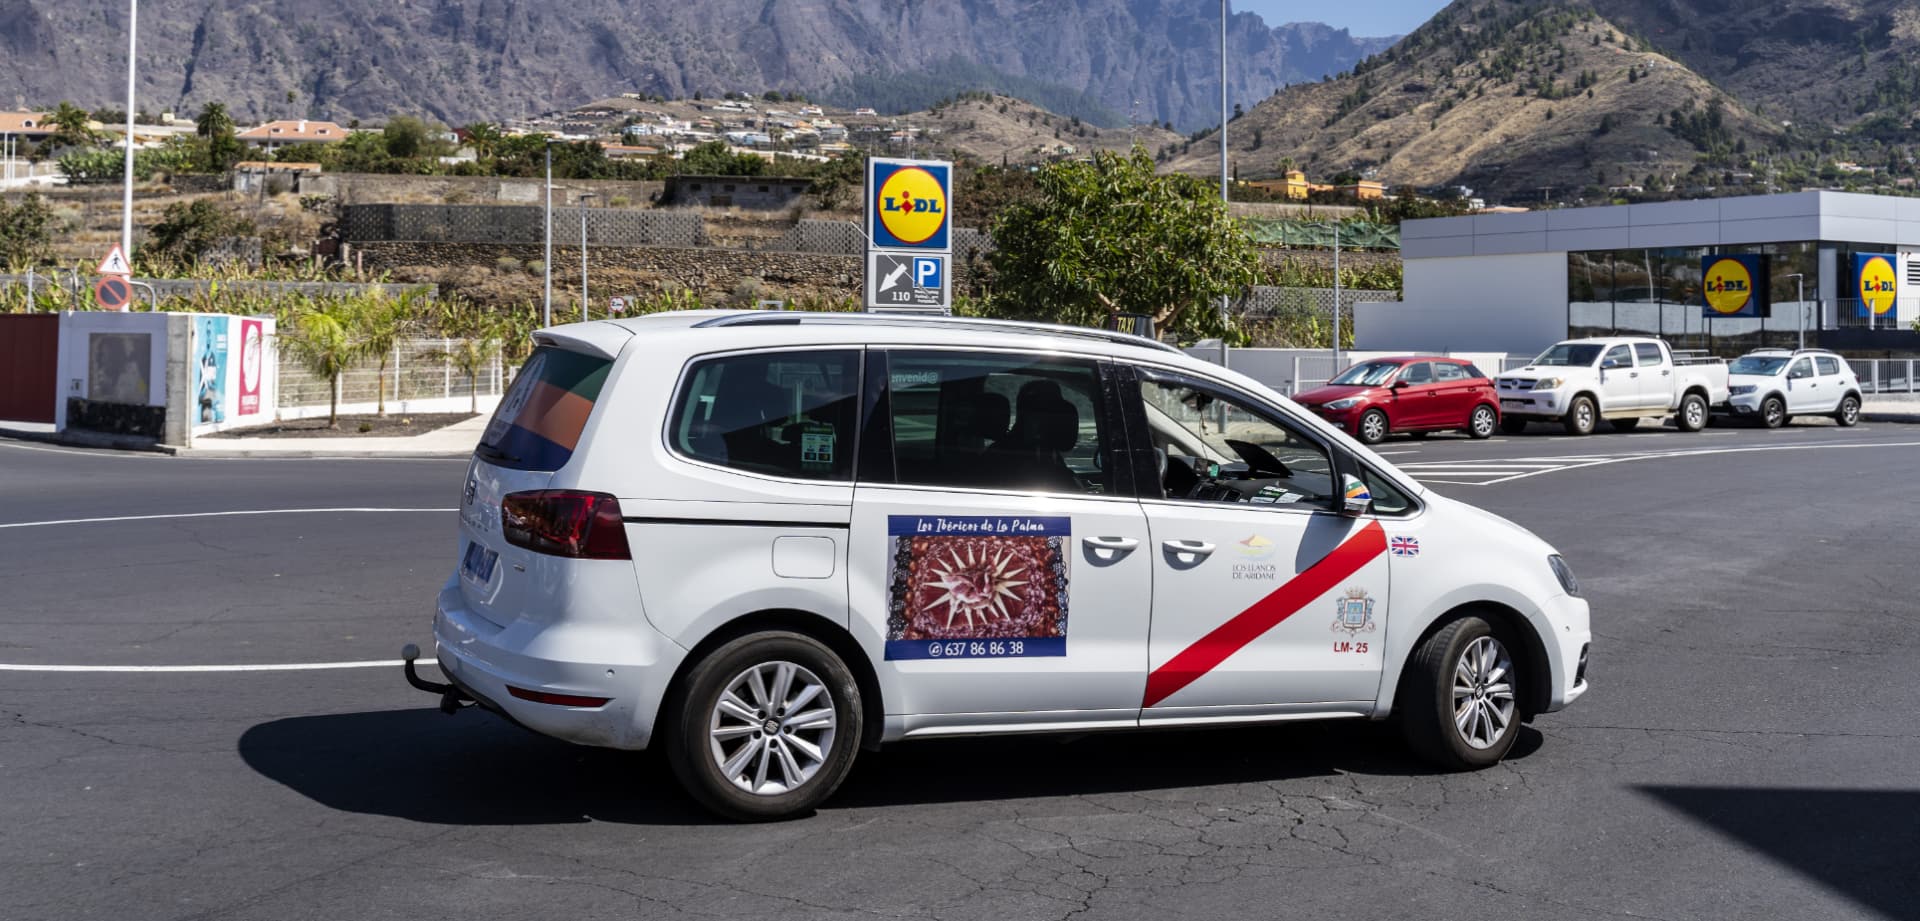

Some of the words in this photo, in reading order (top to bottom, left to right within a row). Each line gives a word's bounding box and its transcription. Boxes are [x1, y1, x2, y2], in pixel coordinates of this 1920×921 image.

[918, 260, 936, 286] P
[892, 291, 910, 302] 110
[1117, 317, 1135, 335] TAXI
[917, 518, 932, 532] Los
[936, 518, 978, 533] Ibéricos
[981, 519, 993, 532] de
[997, 519, 1008, 532] La
[1011, 519, 1045, 533] Palma
[1232, 564, 1247, 572] LOS
[1248, 564, 1276, 572] LLANOS
[1232, 572, 1244, 580] DE
[945, 642, 966, 655] 637
[970, 642, 986, 655] 86
[990, 642, 1005, 655] 86
[1009, 641, 1024, 655] 38
[1333, 642, 1354, 653] LM-
[1356, 642, 1368, 653] 25
